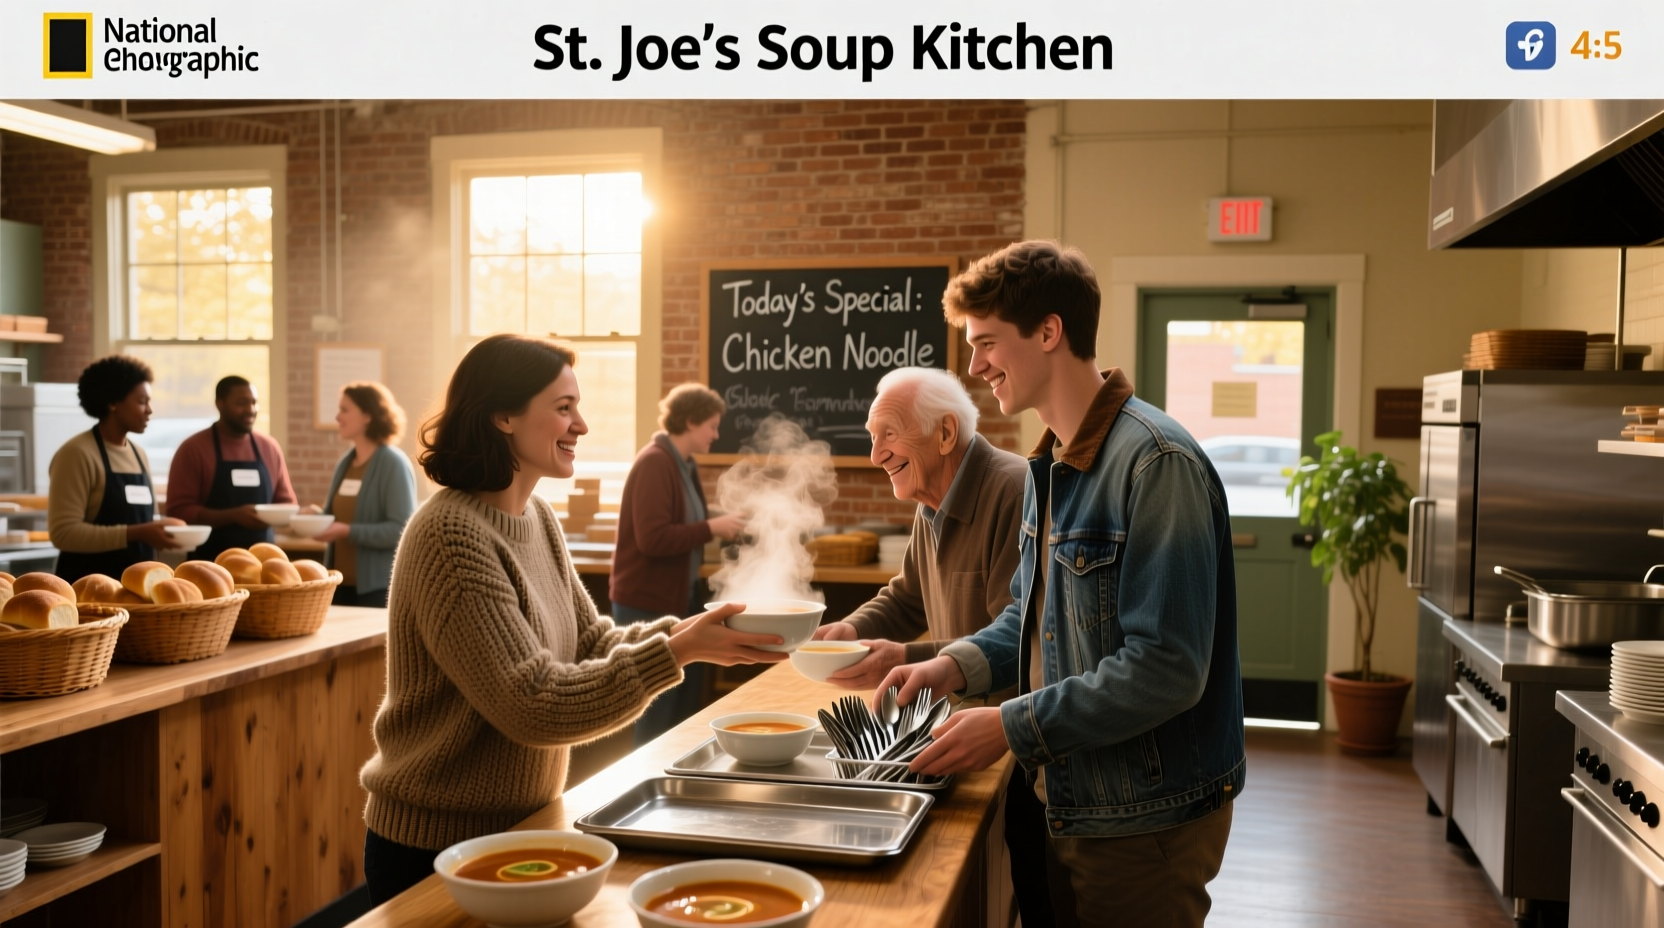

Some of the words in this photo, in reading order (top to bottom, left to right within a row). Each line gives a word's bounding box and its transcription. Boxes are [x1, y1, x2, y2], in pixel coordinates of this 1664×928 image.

[721, 279, 816, 328] Today's
[823, 276, 923, 327] Special:
[721, 331, 832, 373] Chicken
[842, 329, 935, 371] Noodle
